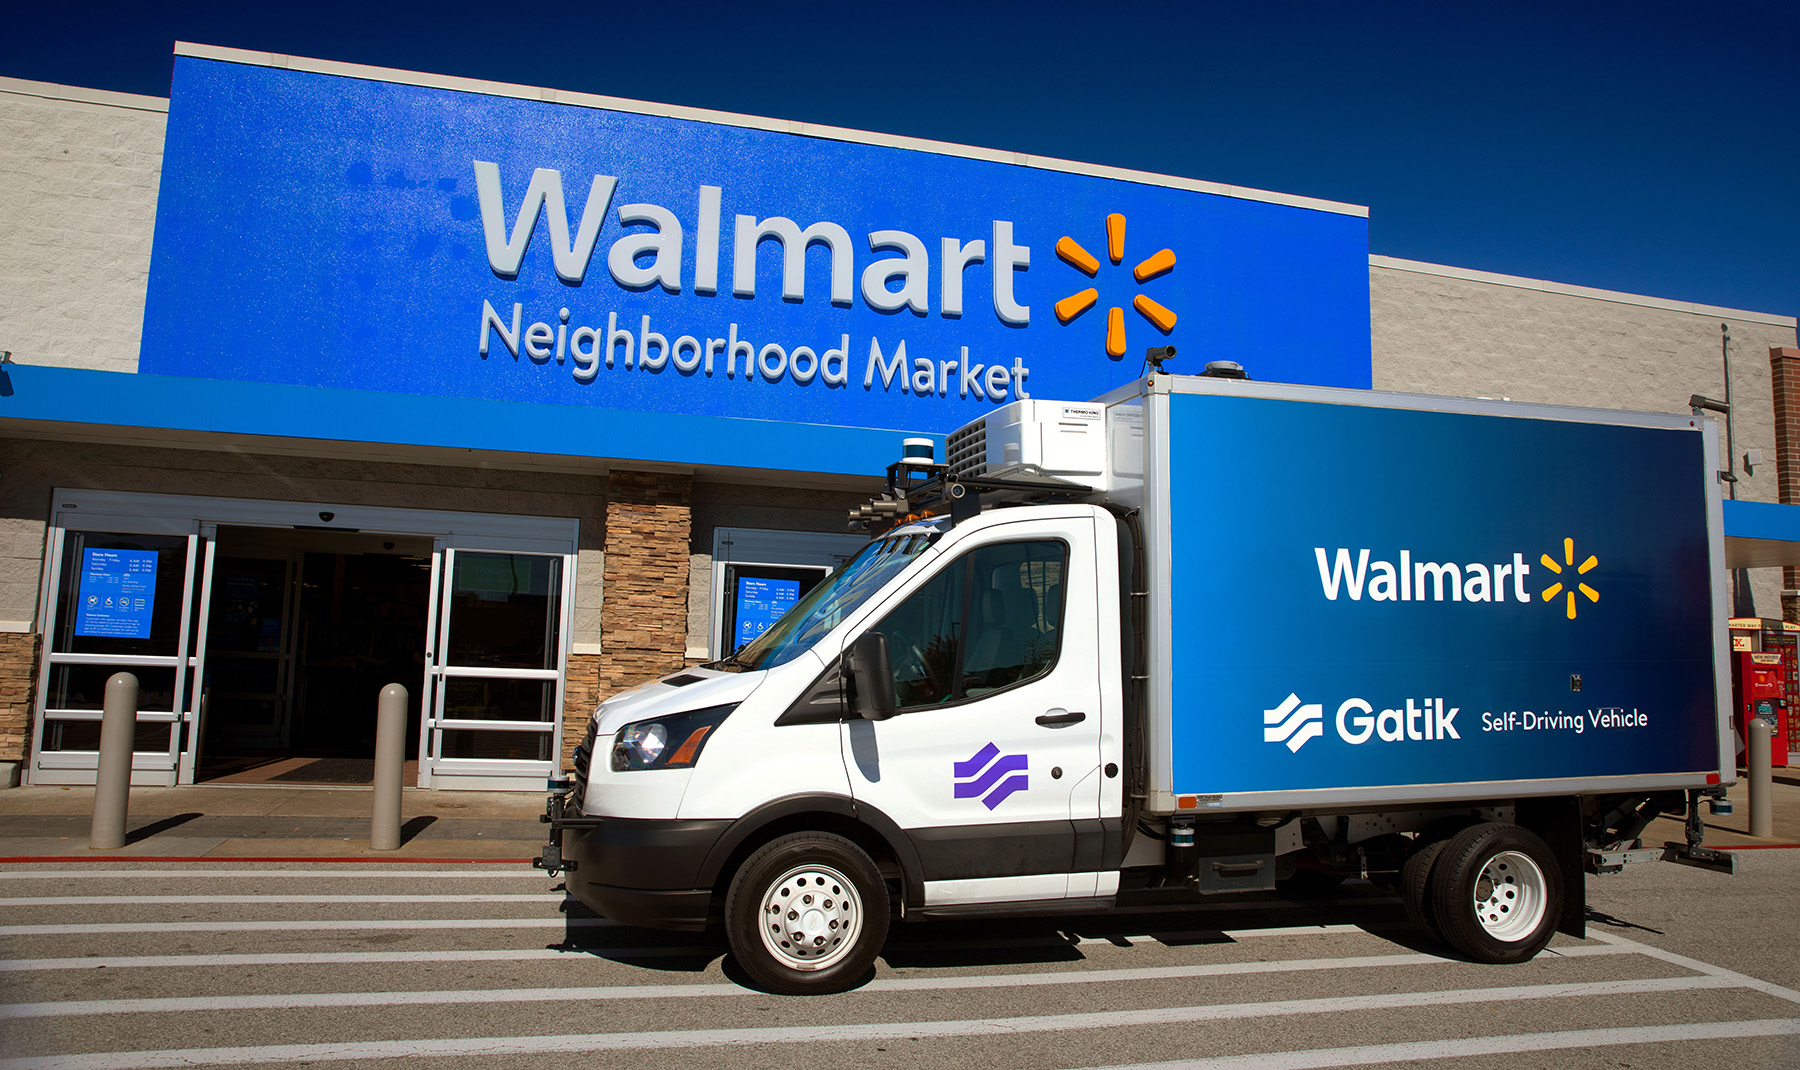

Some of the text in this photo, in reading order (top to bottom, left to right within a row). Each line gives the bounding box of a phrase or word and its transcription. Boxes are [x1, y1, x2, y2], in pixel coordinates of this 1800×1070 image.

[473, 160, 1031, 327] Walmart
[479, 299, 1030, 400] Neighborhood Market
[1314, 547, 1531, 603] Walmart
[1335, 697, 1460, 745] Gatik
[1481, 708, 1648, 734] Self-Driving Vehicle
